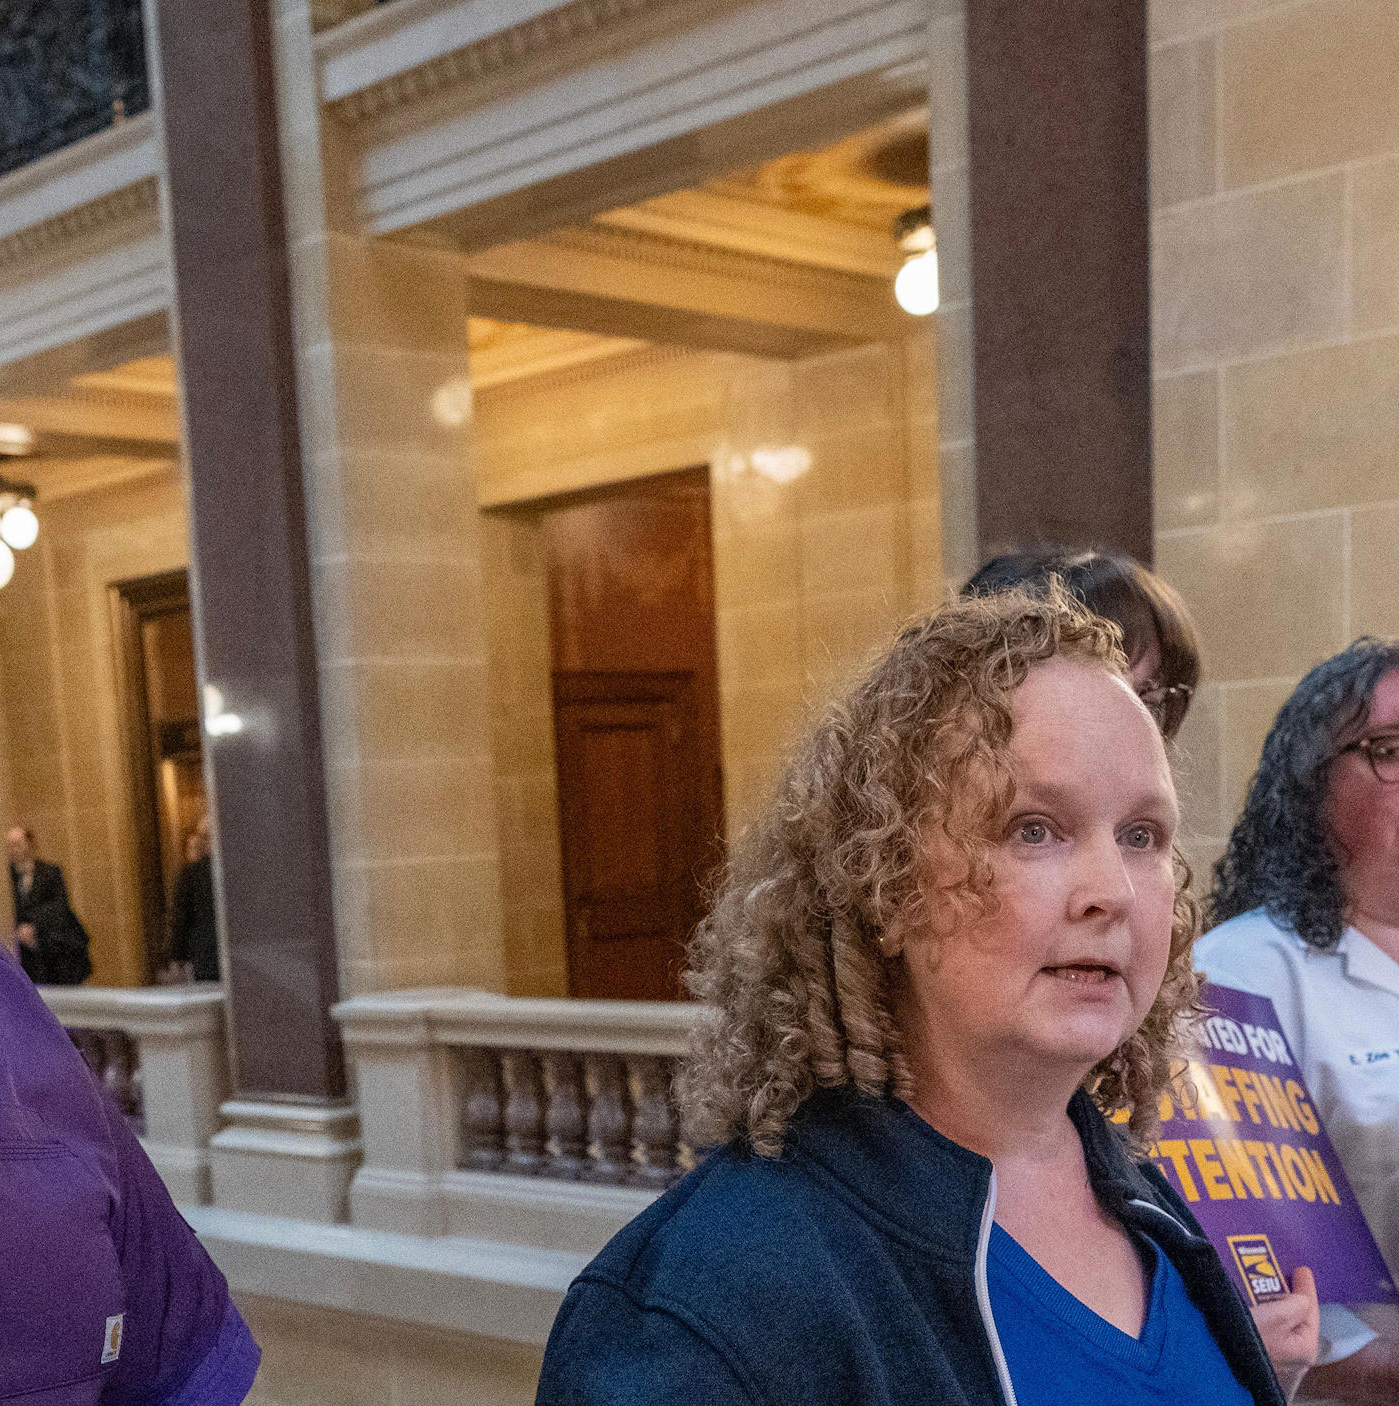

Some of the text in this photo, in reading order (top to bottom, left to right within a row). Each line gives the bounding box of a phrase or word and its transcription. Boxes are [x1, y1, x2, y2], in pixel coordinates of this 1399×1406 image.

[1242, 1022, 1293, 1066] FOR
[1148, 1139, 1342, 1206] TENTION
[1251, 1276, 1281, 1294] SEIU
